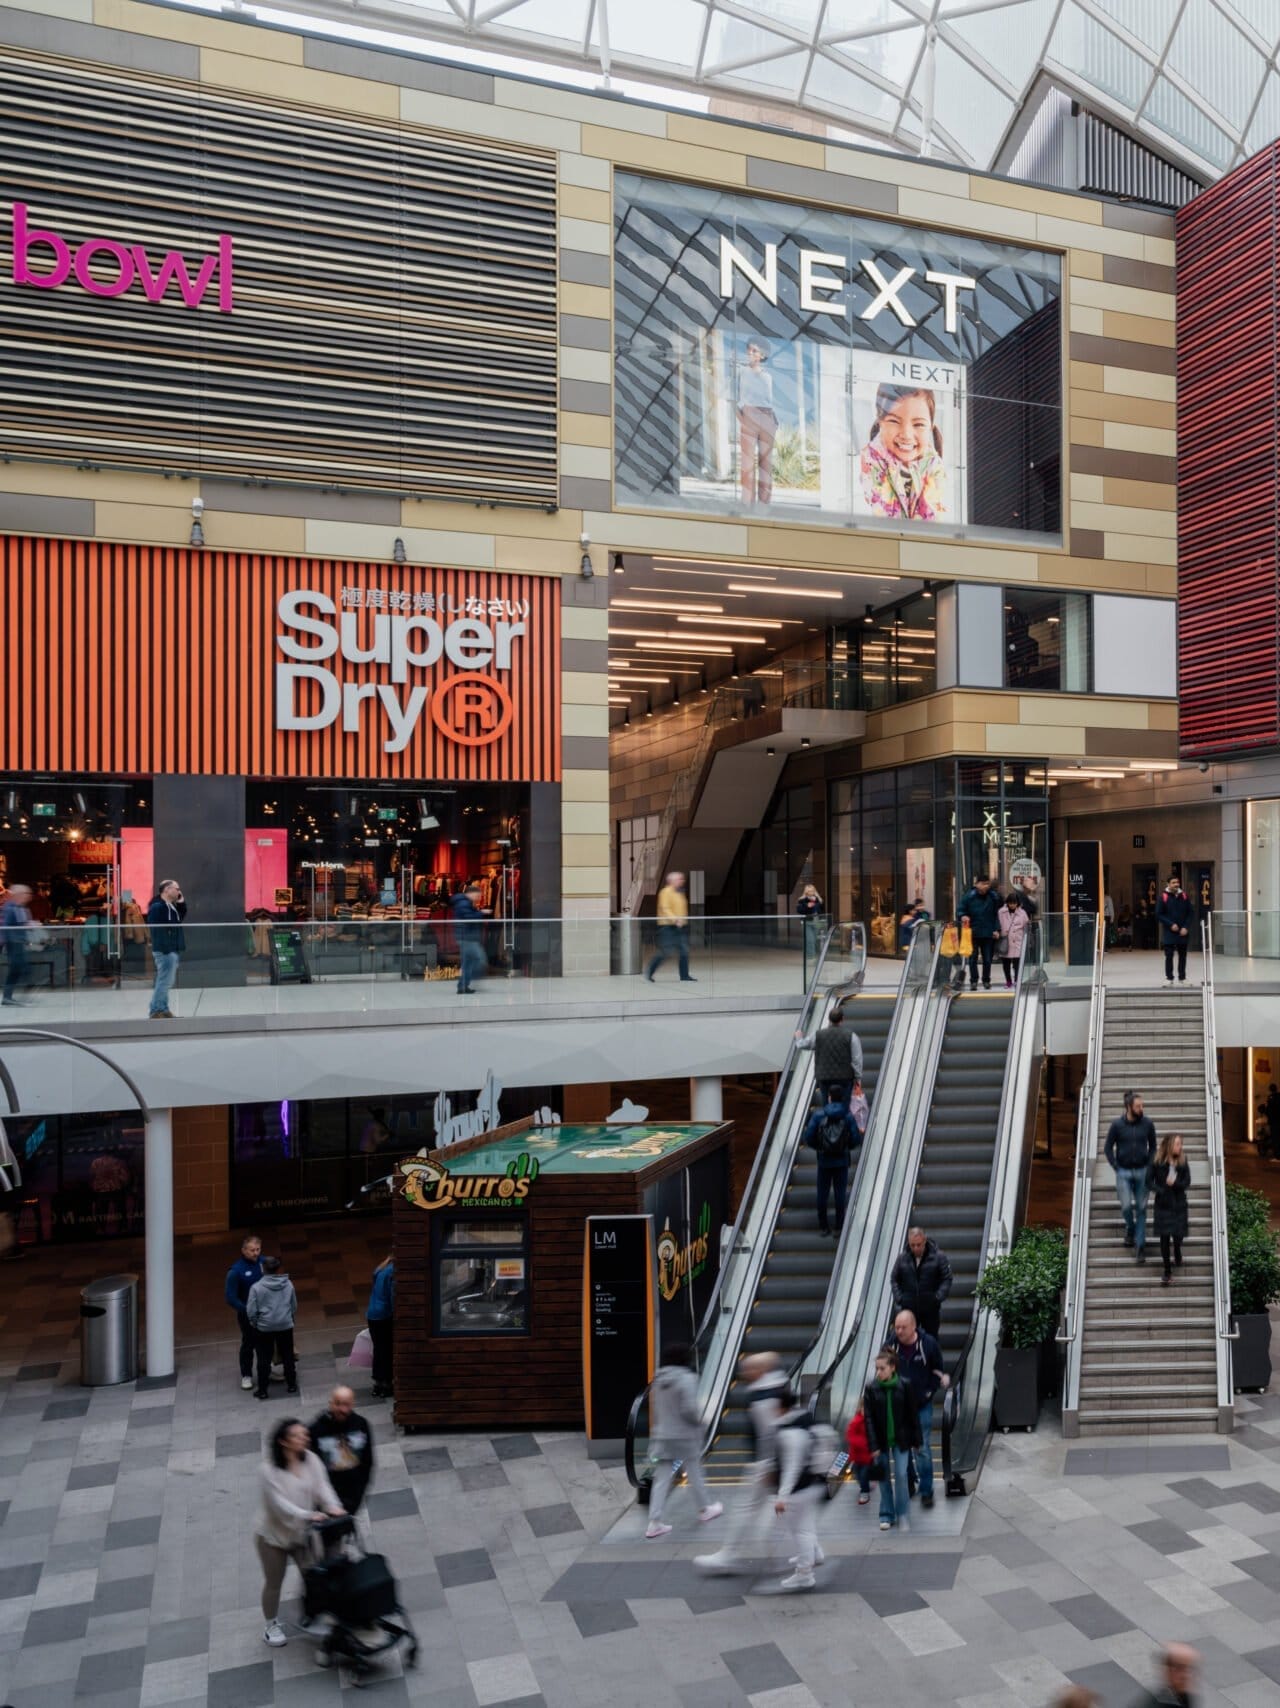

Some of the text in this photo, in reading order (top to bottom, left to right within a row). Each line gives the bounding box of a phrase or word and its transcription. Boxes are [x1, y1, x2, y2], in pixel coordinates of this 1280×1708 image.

[13, 202, 232, 312] bowl
[719, 234, 976, 334] NEXT
[891, 361, 955, 385] NEXT
[340, 586, 530, 618] 極度乾燥(しなさい)
[276, 590, 526, 684] Super
[276, 662, 429, 753] Dry
[404, 1169, 530, 1210] Churros
[594, 1231, 616, 1244] LM
